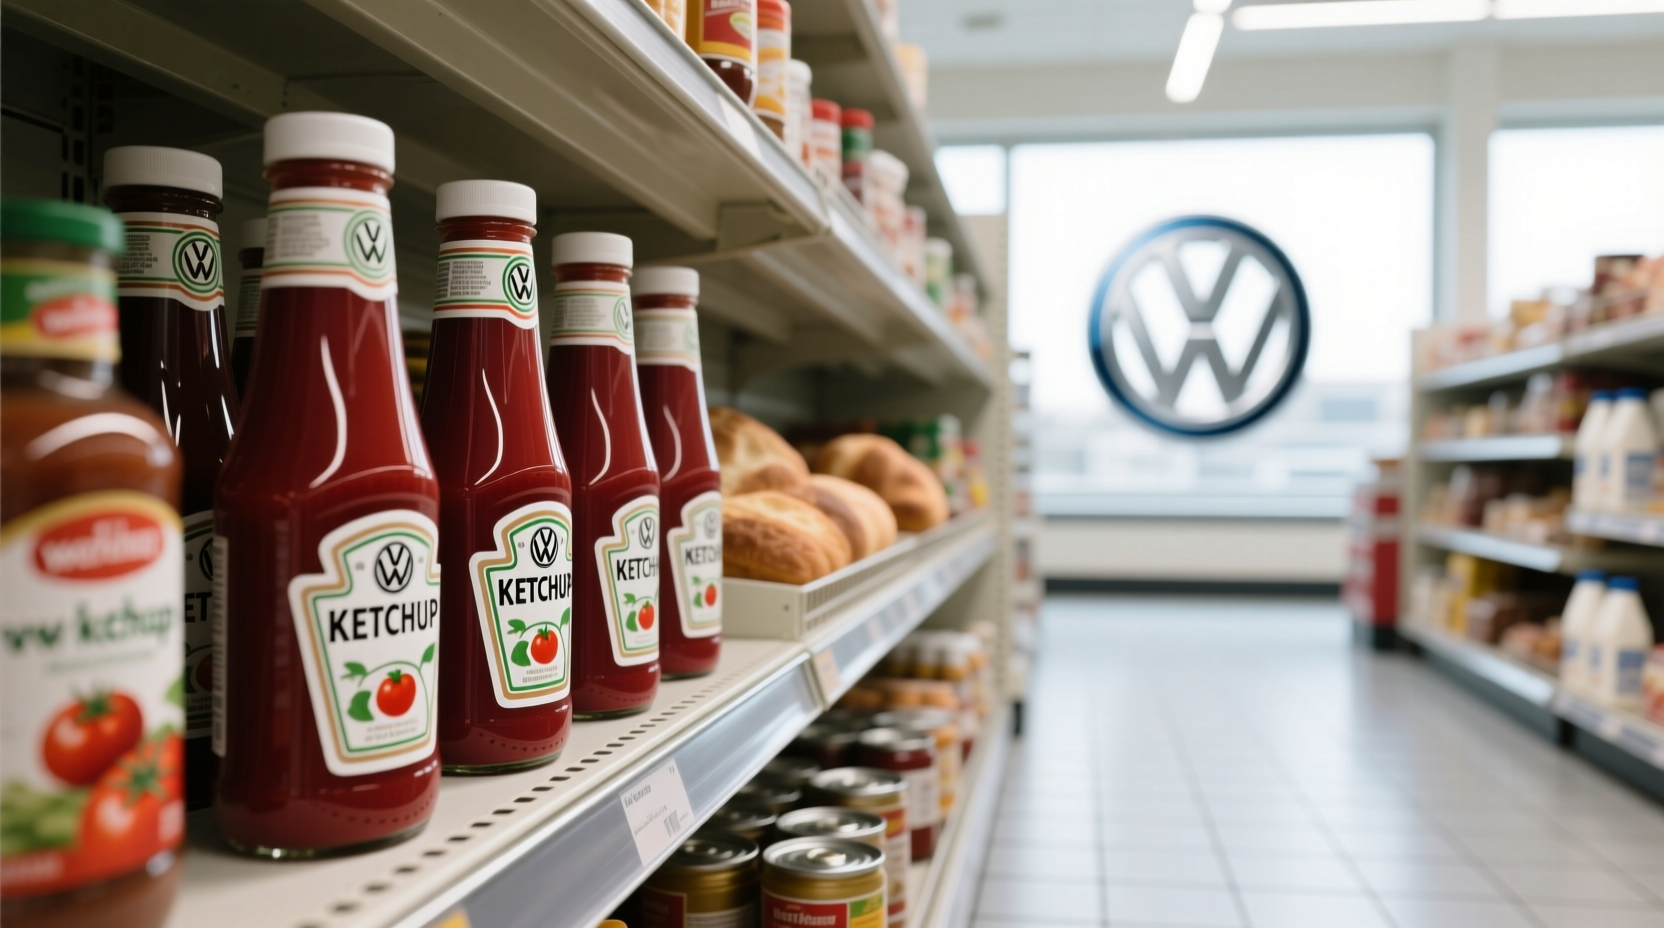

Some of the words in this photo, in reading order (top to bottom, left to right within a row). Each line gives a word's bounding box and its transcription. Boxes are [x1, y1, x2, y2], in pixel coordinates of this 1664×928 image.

[1102, 230, 1297, 412] VW
[498, 572, 572, 607] KETCHUP
[328, 598, 439, 643] KETCHUP
